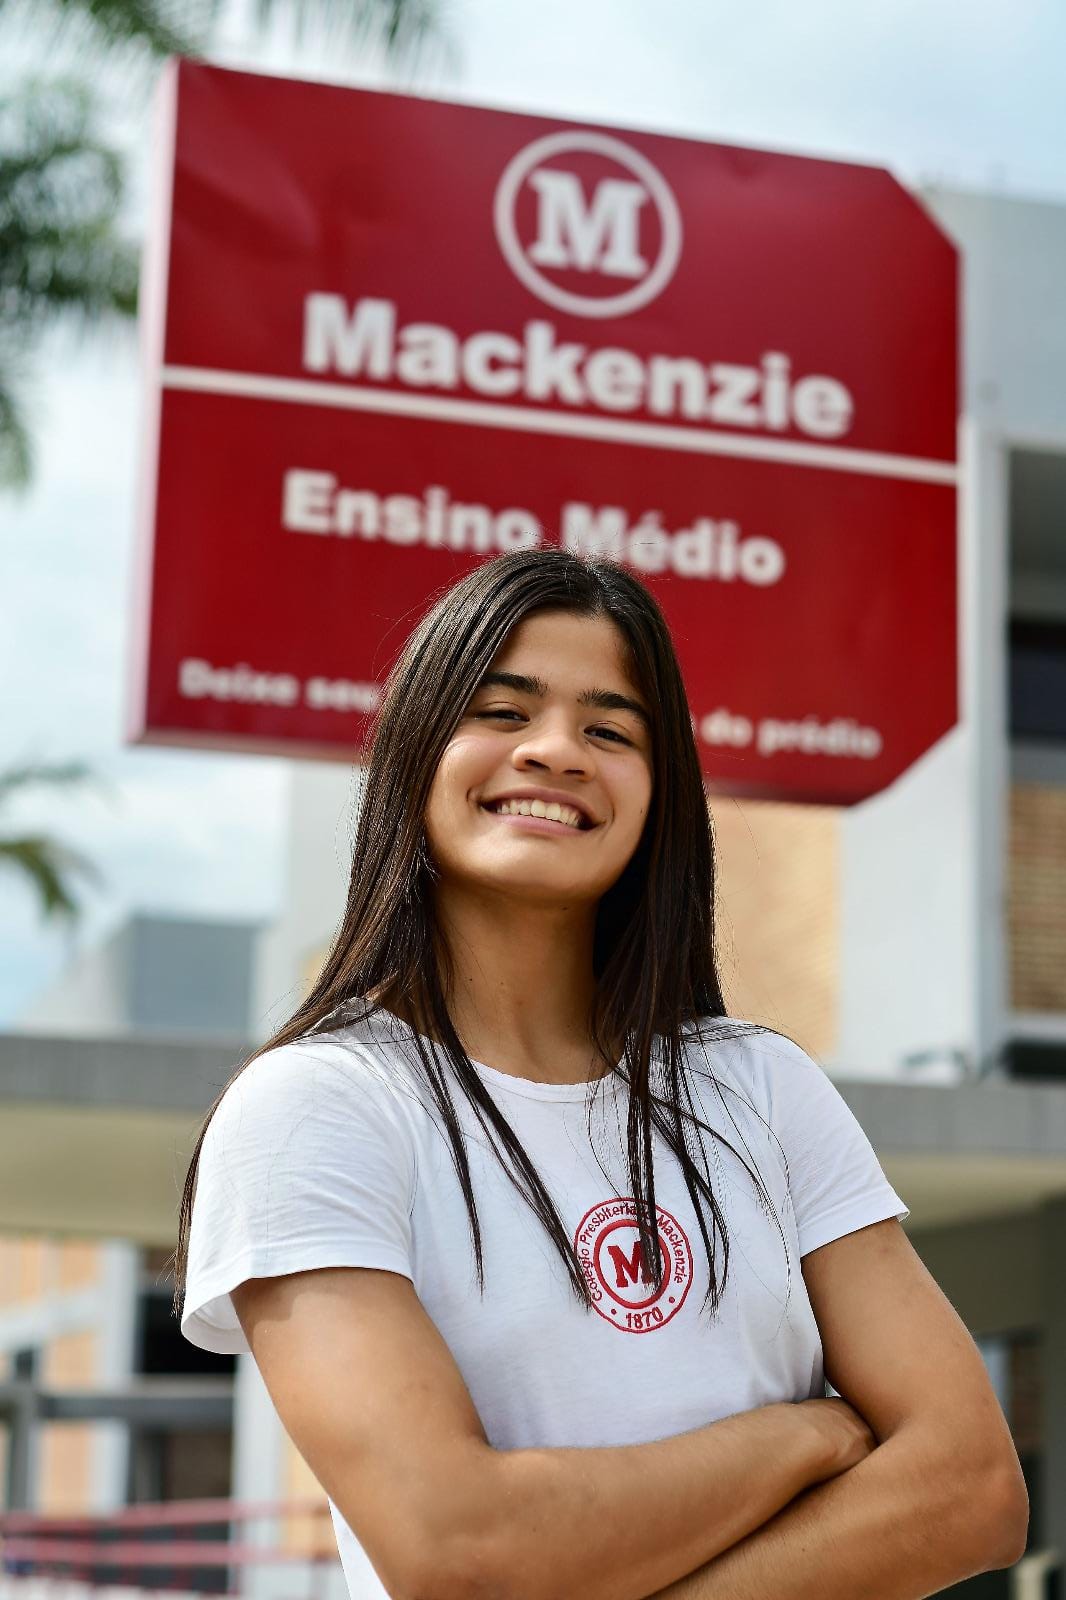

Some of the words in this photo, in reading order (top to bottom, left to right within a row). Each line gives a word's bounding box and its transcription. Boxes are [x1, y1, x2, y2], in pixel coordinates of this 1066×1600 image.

[527, 167, 648, 279] M
[303, 292, 853, 438] Mackenzie
[282, 468, 541, 553] Ensino
[561, 503, 786, 587] Médio
[607, 1240, 655, 1288] M
[656, 1214, 686, 1284] Mackenzie
[625, 1306, 664, 1330] 1870
